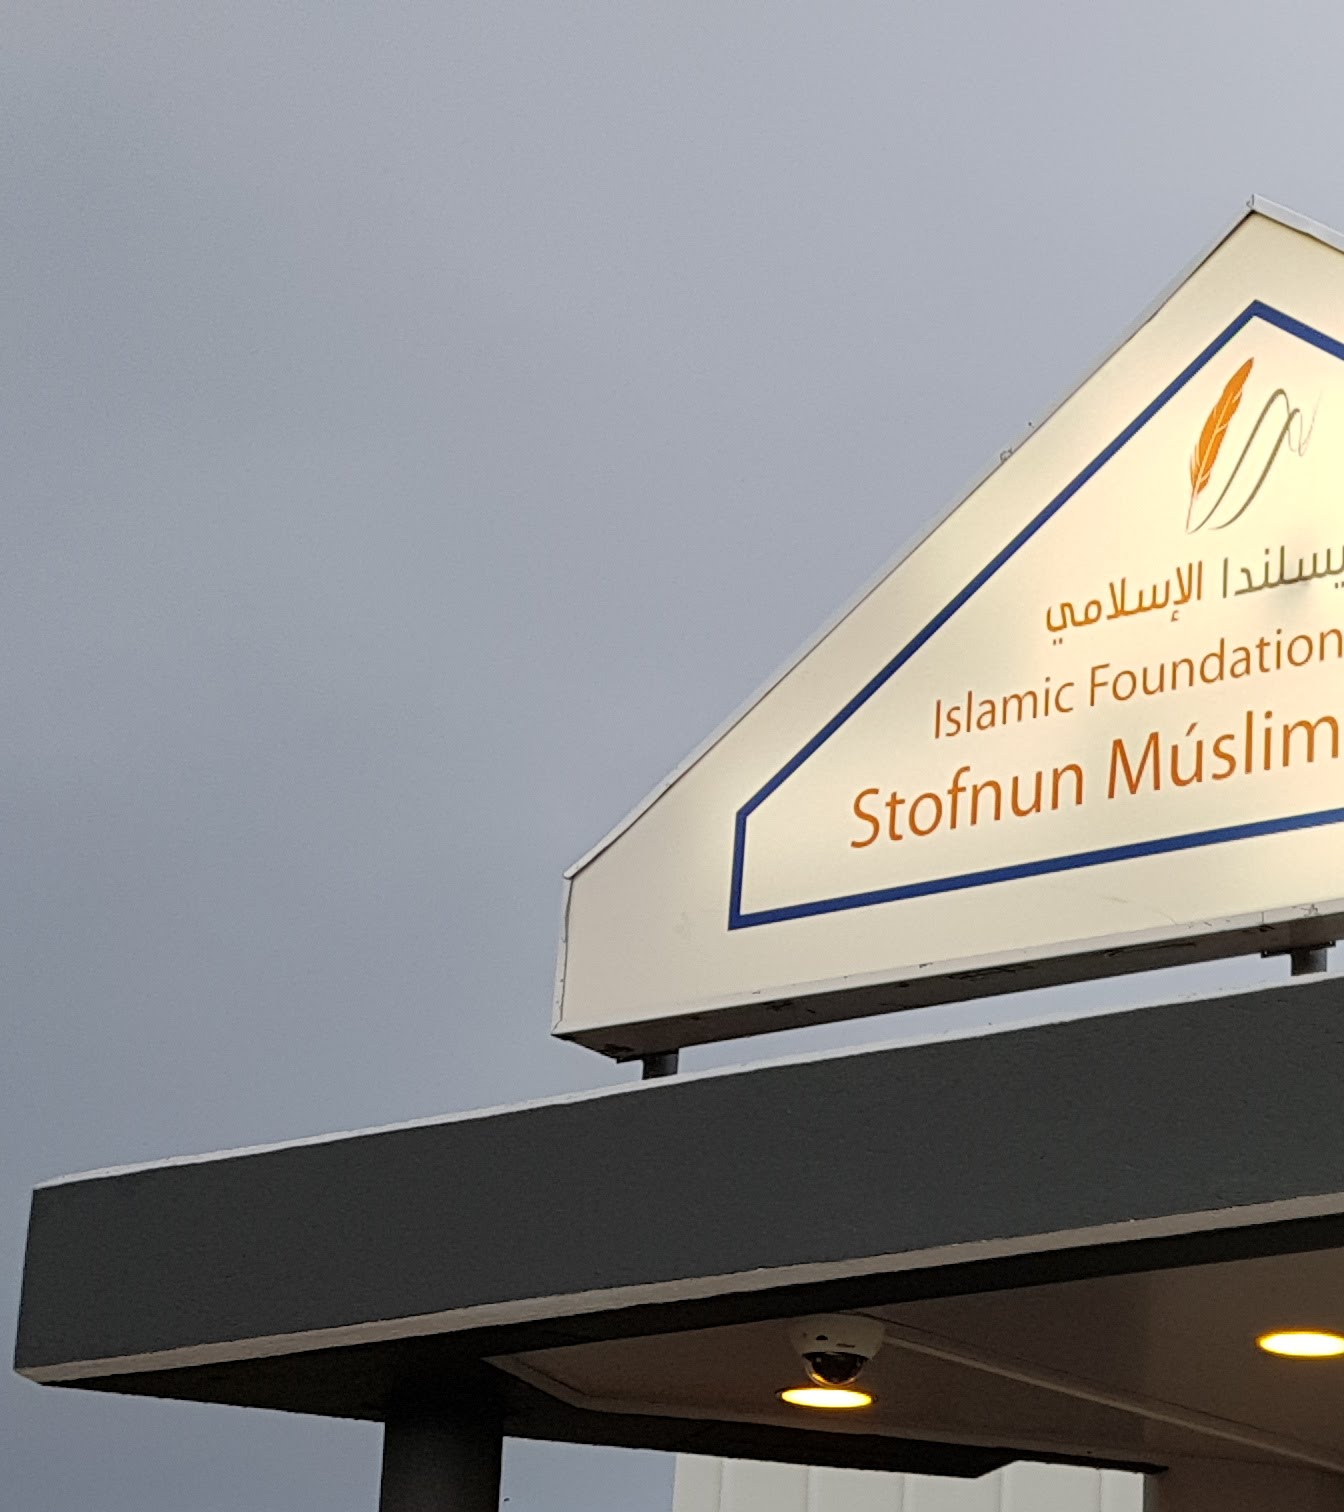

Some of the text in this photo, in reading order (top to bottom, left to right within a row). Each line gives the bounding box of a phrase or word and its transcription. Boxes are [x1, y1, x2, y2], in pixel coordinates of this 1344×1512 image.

[1046, 560, 1203, 645] الإسلامي
[934, 677, 1074, 739] Islamic
[1089, 628, 1343, 707] Foundation
[849, 761, 1084, 848] Stofnun
